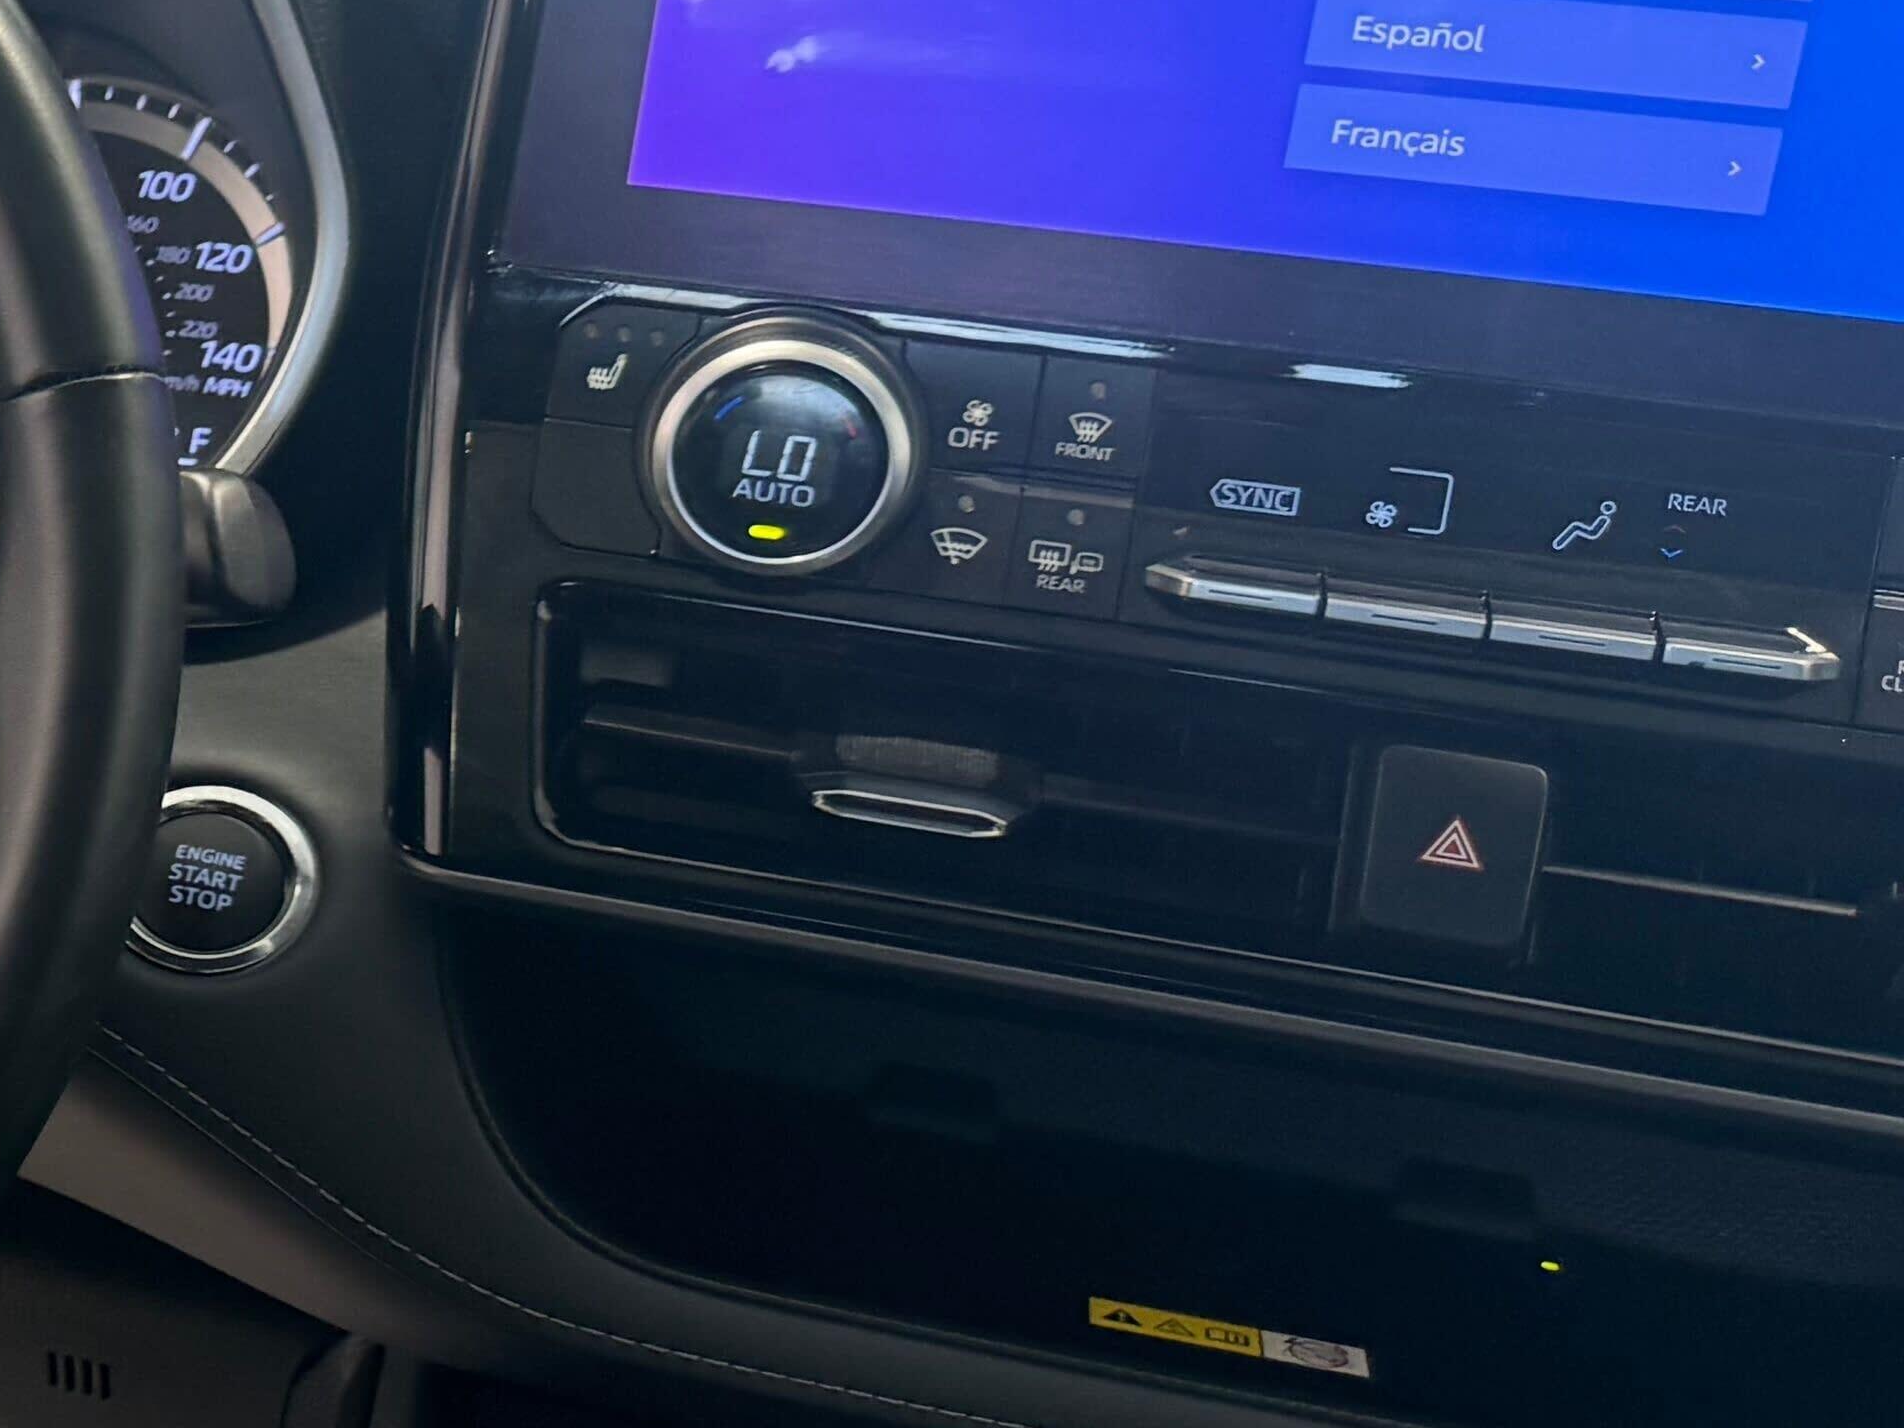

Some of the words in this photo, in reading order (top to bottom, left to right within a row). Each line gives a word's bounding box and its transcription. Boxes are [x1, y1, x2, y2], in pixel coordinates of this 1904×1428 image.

[1352, 14, 1485, 53] Español
[1330, 119, 1466, 158] Français
[138, 169, 198, 203] 100
[195, 241, 252, 274] 120
[174, 282, 215, 303] 200
[178, 320, 218, 339] 220
[200, 339, 263, 373] 140
[203, 376, 252, 398] MPH
[189, 426, 212, 455] F
[948, 427, 999, 452] OFF
[1055, 441, 1115, 462] FRONT
[732, 481, 817, 508] AUTO
[1219, 483, 1291, 513] SYNC
[1667, 492, 1728, 517] REAR
[1035, 574, 1086, 593] REAR
[175, 845, 247, 870] ENGINE
[168, 863, 243, 892] START
[168, 884, 233, 912] STOP
